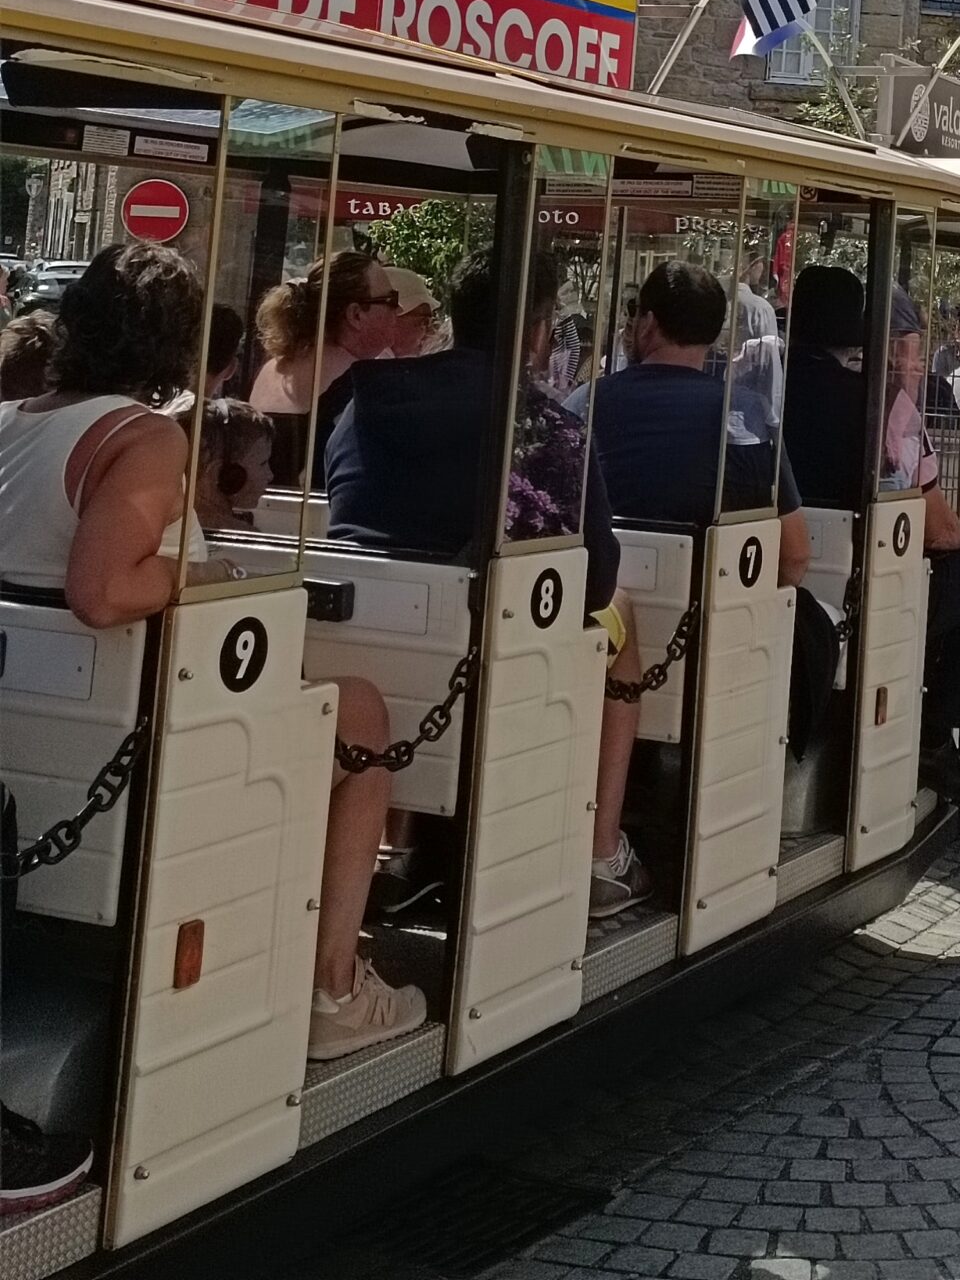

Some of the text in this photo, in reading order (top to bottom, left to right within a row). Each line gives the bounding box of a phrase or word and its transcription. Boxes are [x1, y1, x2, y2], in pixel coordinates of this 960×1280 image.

[537, 209, 580, 225] oto
[897, 519, 905, 549] 6
[746, 545, 757, 579] 7
[540, 578, 554, 618] 8
[235, 630, 255, 680] 9
